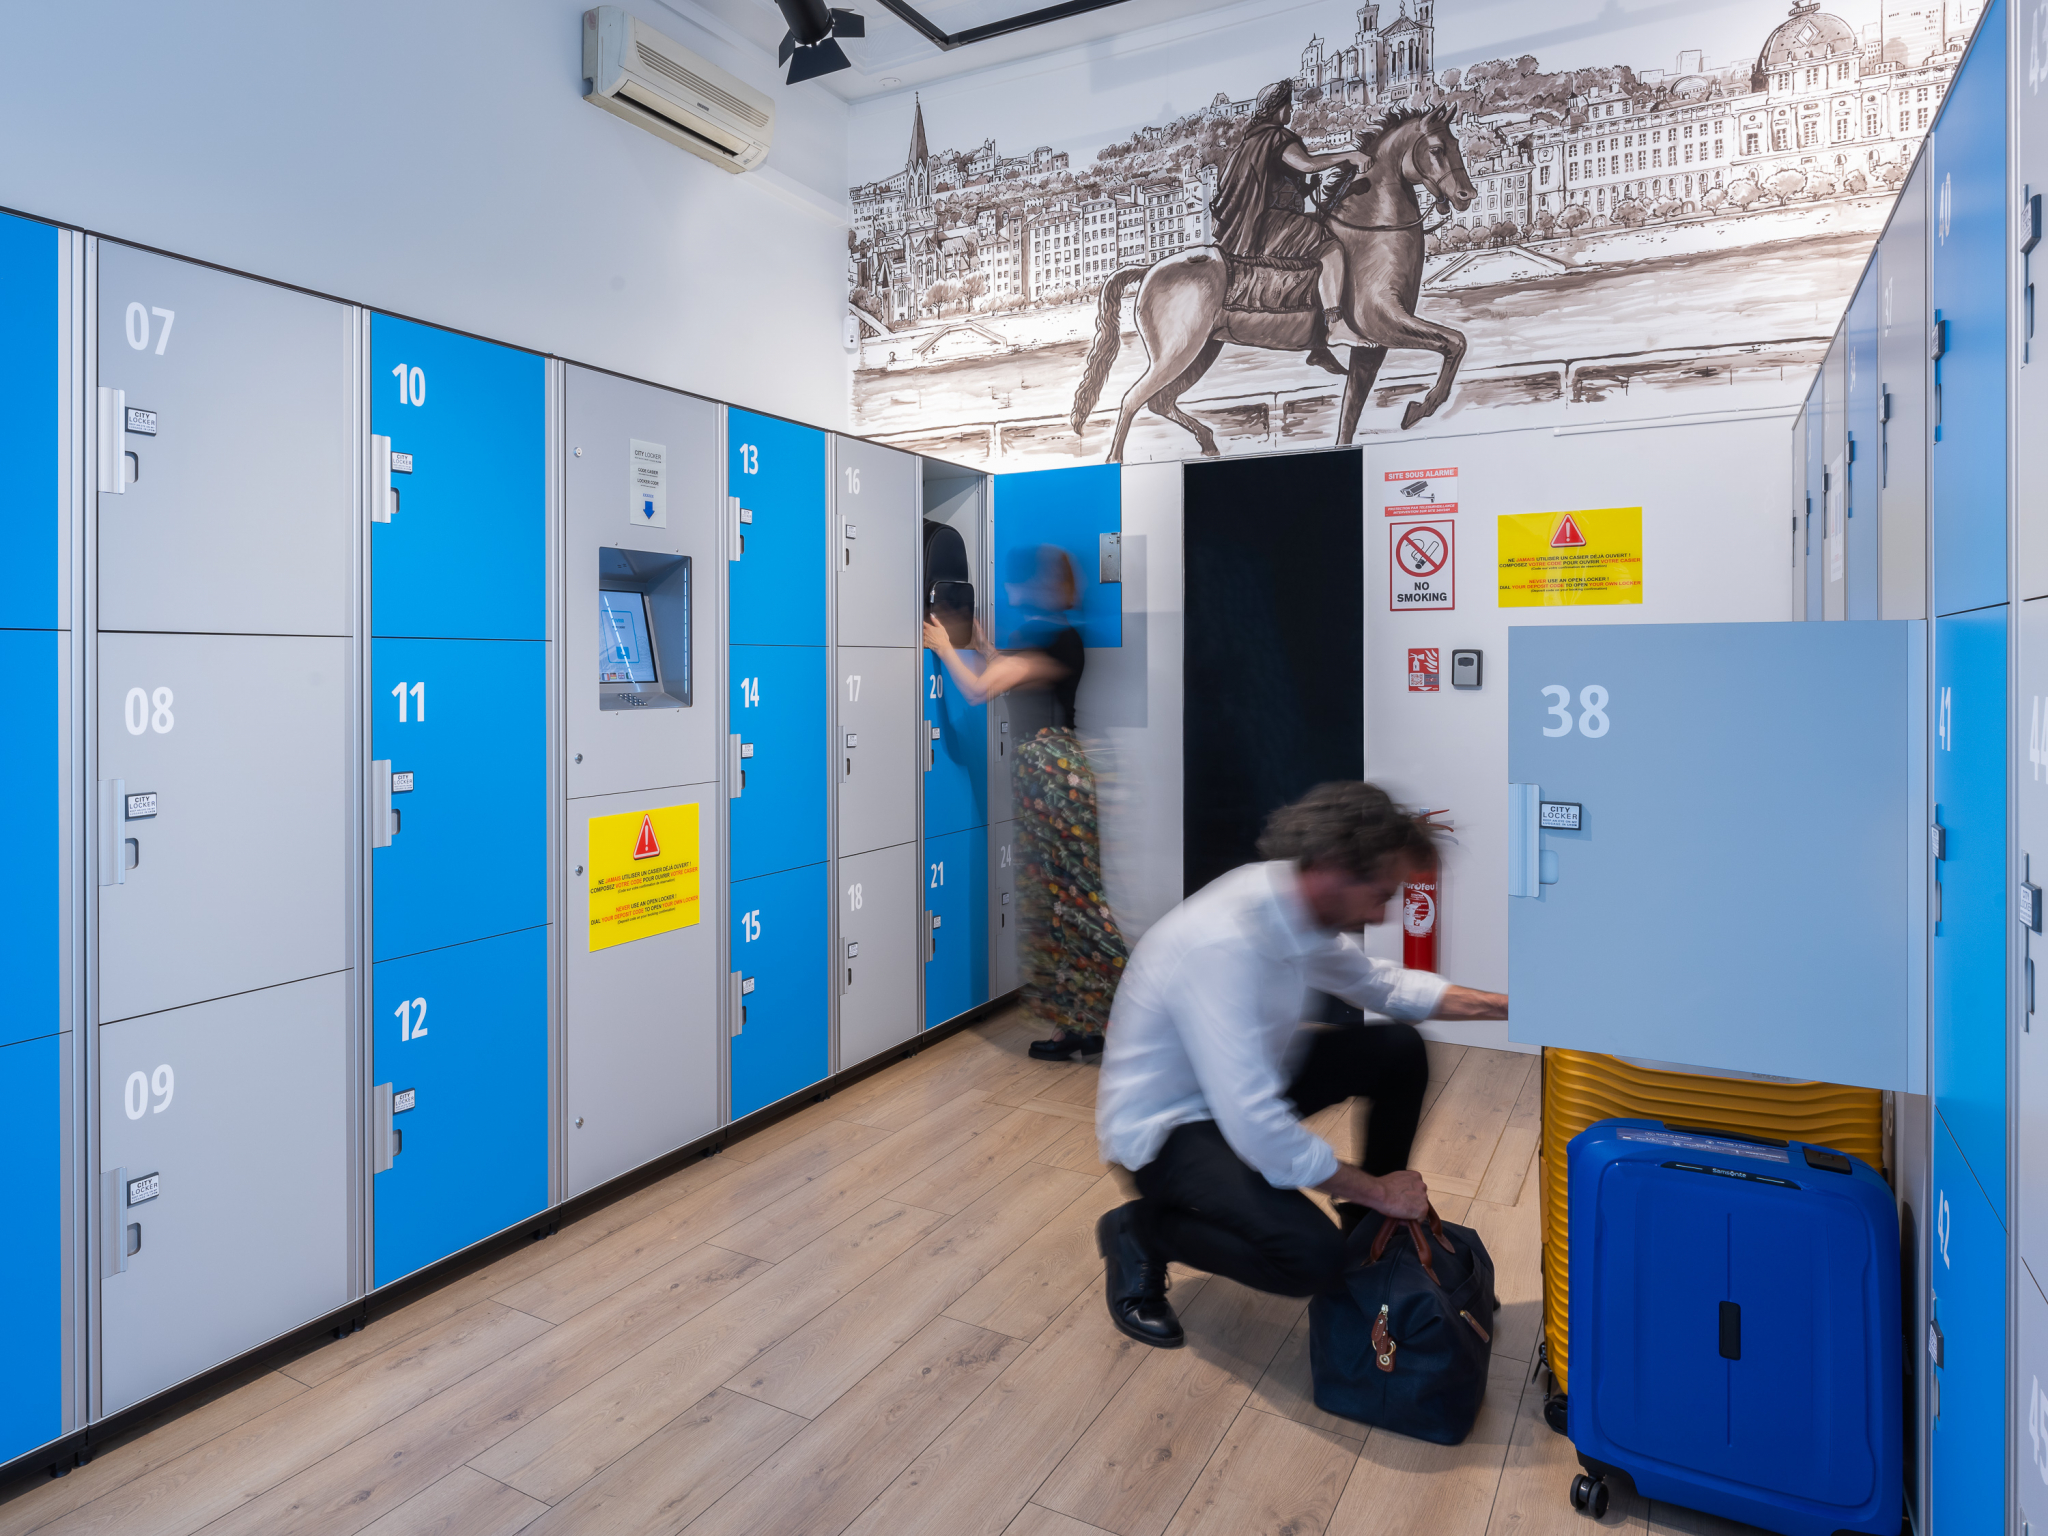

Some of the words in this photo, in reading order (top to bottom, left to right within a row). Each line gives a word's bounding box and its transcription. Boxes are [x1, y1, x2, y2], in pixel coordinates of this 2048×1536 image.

[1939, 172, 1950, 246] 40
[126, 302, 174, 355] 07
[392, 363, 425, 406] 10
[129, 417, 155, 425] LOCKER
[740, 444, 758, 474] 13
[1425, 469, 1454, 477] ALARME
[845, 466, 860, 494] 16
[1397, 592, 1447, 602] SMOKING
[1414, 582, 1429, 590] NO
[741, 677, 759, 707] 14
[846, 674, 861, 702] 17
[930, 674, 943, 698] 20
[125, 687, 174, 735] 08
[392, 682, 424, 722] 11
[1541, 685, 1609, 738] 38
[1939, 686, 1951, 752] 41
[130, 801, 155, 809] LOCKER
[1001, 844, 1011, 868] 24
[590, 884, 615, 894] COMPOSEZ
[655, 872, 670, 880] OUVRIR
[931, 862, 944, 888] 21
[614, 911, 632, 920] DEPOSIT
[683, 895, 698, 903] LOCKER
[659, 895, 674, 903] LOCKER
[848, 883, 862, 911] 18
[742, 910, 760, 942] 15
[394, 997, 427, 1041] 12
[125, 1064, 174, 1120] 09
[137, 1179, 152, 1188] CITY
[1712, 1167, 1746, 1178] Samsonite
[132, 1183, 158, 1196] LOCKER
[1938, 1189, 1950, 1270] 42
